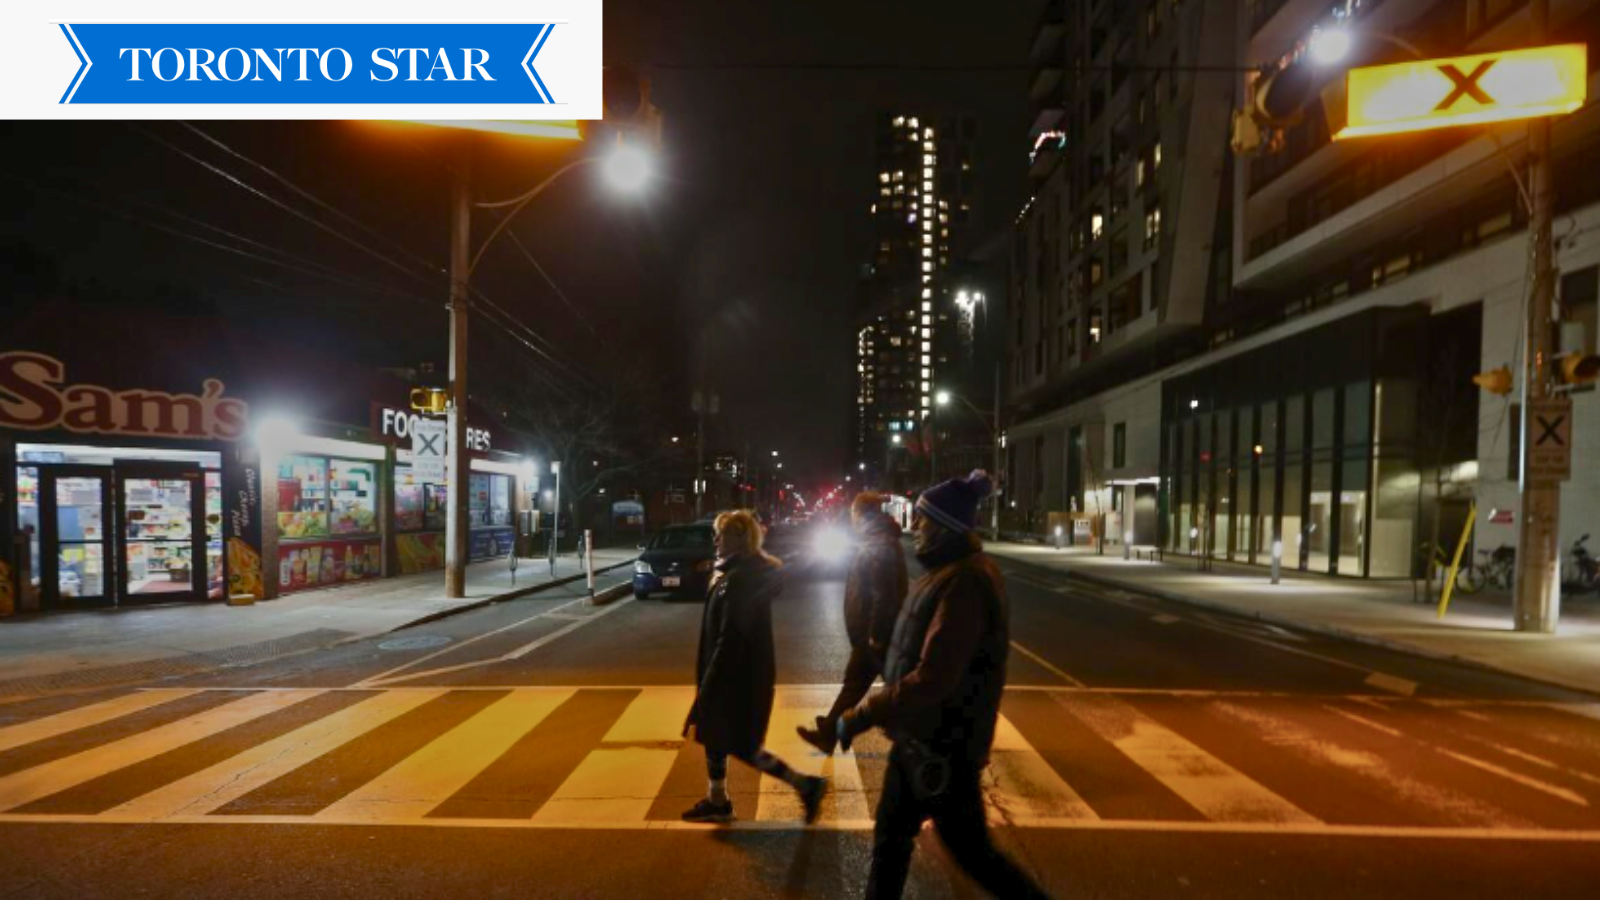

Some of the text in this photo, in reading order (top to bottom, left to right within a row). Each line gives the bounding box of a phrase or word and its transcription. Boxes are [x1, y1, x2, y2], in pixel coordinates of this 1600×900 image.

[1434, 59, 1499, 111] X
[0, 352, 248, 440] Sam's
[417, 433, 441, 456] X
[1535, 414, 1566, 447] X
